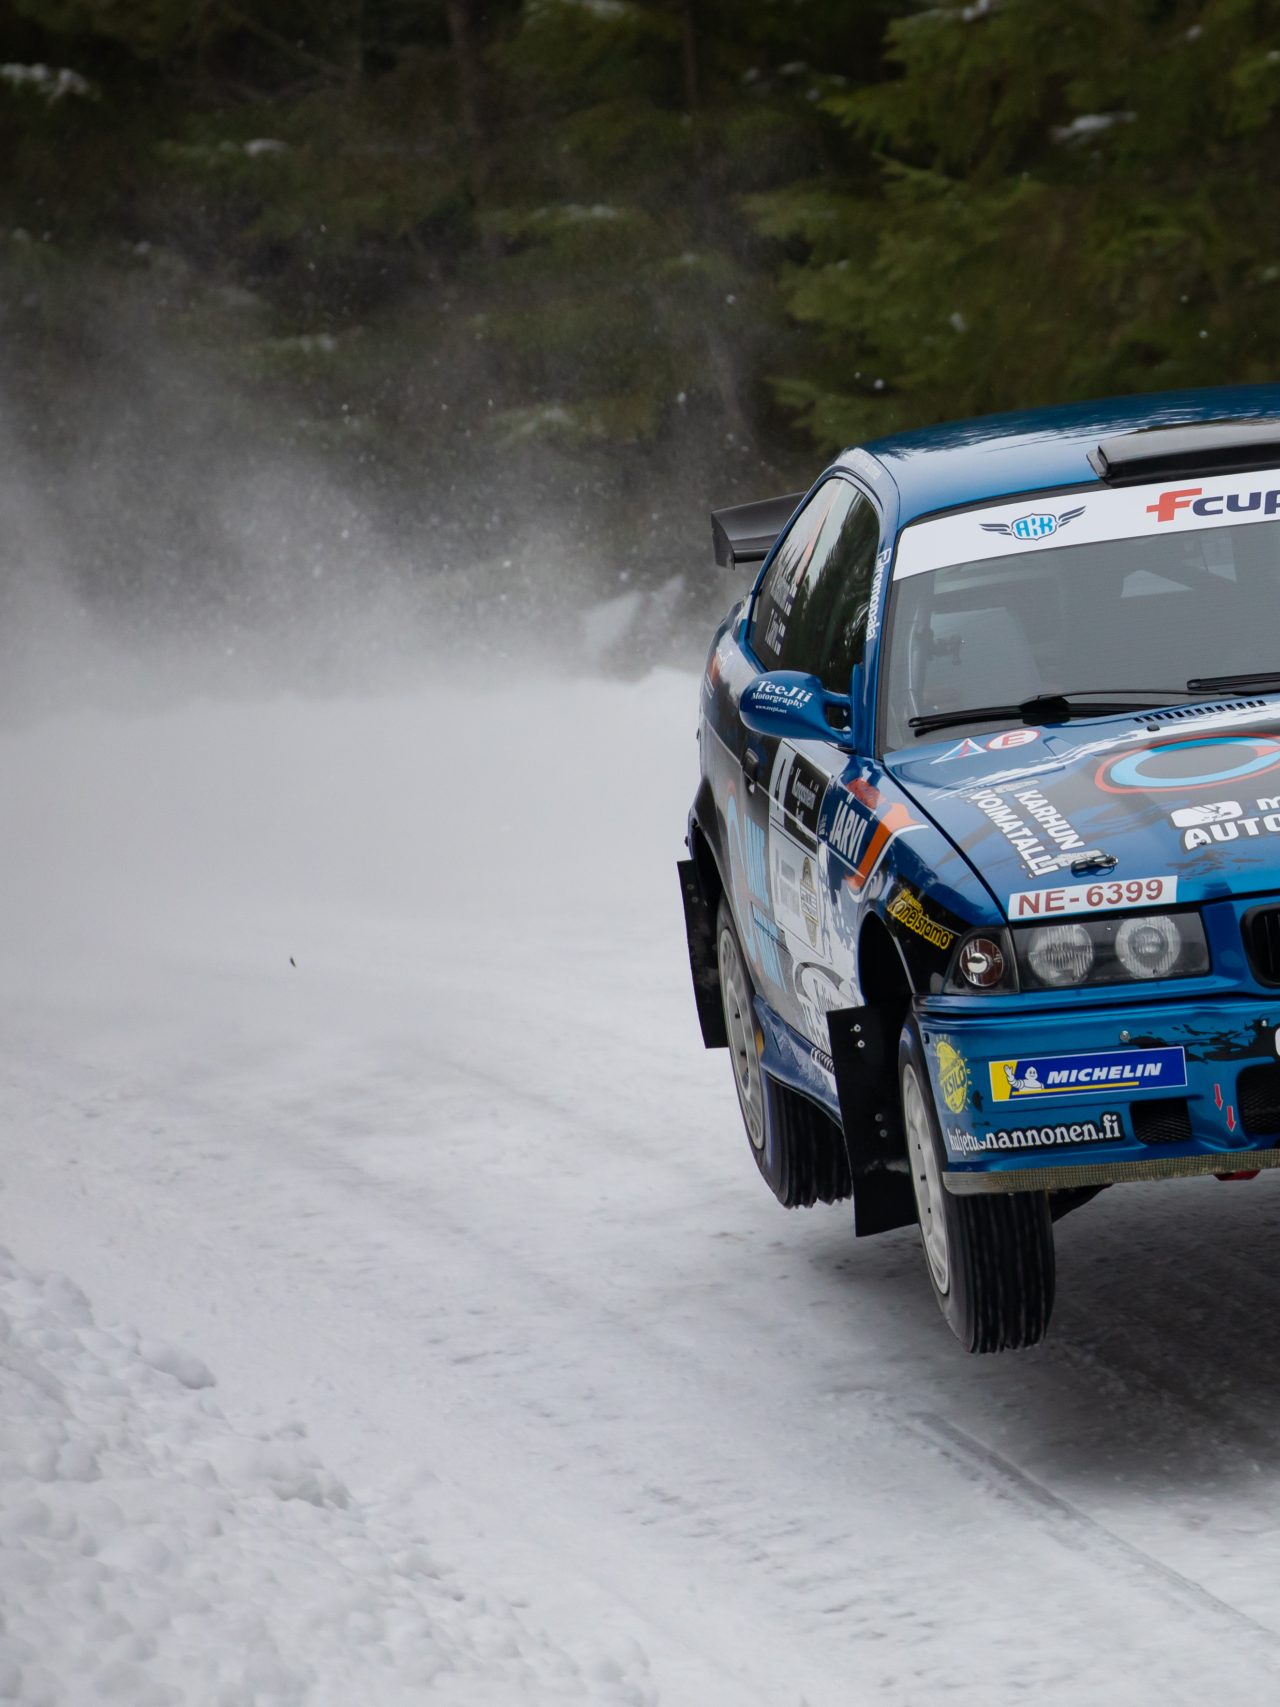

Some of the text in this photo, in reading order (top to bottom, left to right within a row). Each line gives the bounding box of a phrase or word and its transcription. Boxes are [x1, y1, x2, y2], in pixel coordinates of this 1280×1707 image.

[751, 692, 805, 709] Motorgraphy
[756, 680, 814, 703] TeeJii
[970, 789, 1060, 877] VOIMATALLI
[1014, 789, 1086, 851] KARHUN
[1018, 878, 1164, 916] NE-6399
[1046, 1062, 1162, 1085] MICHELIN
